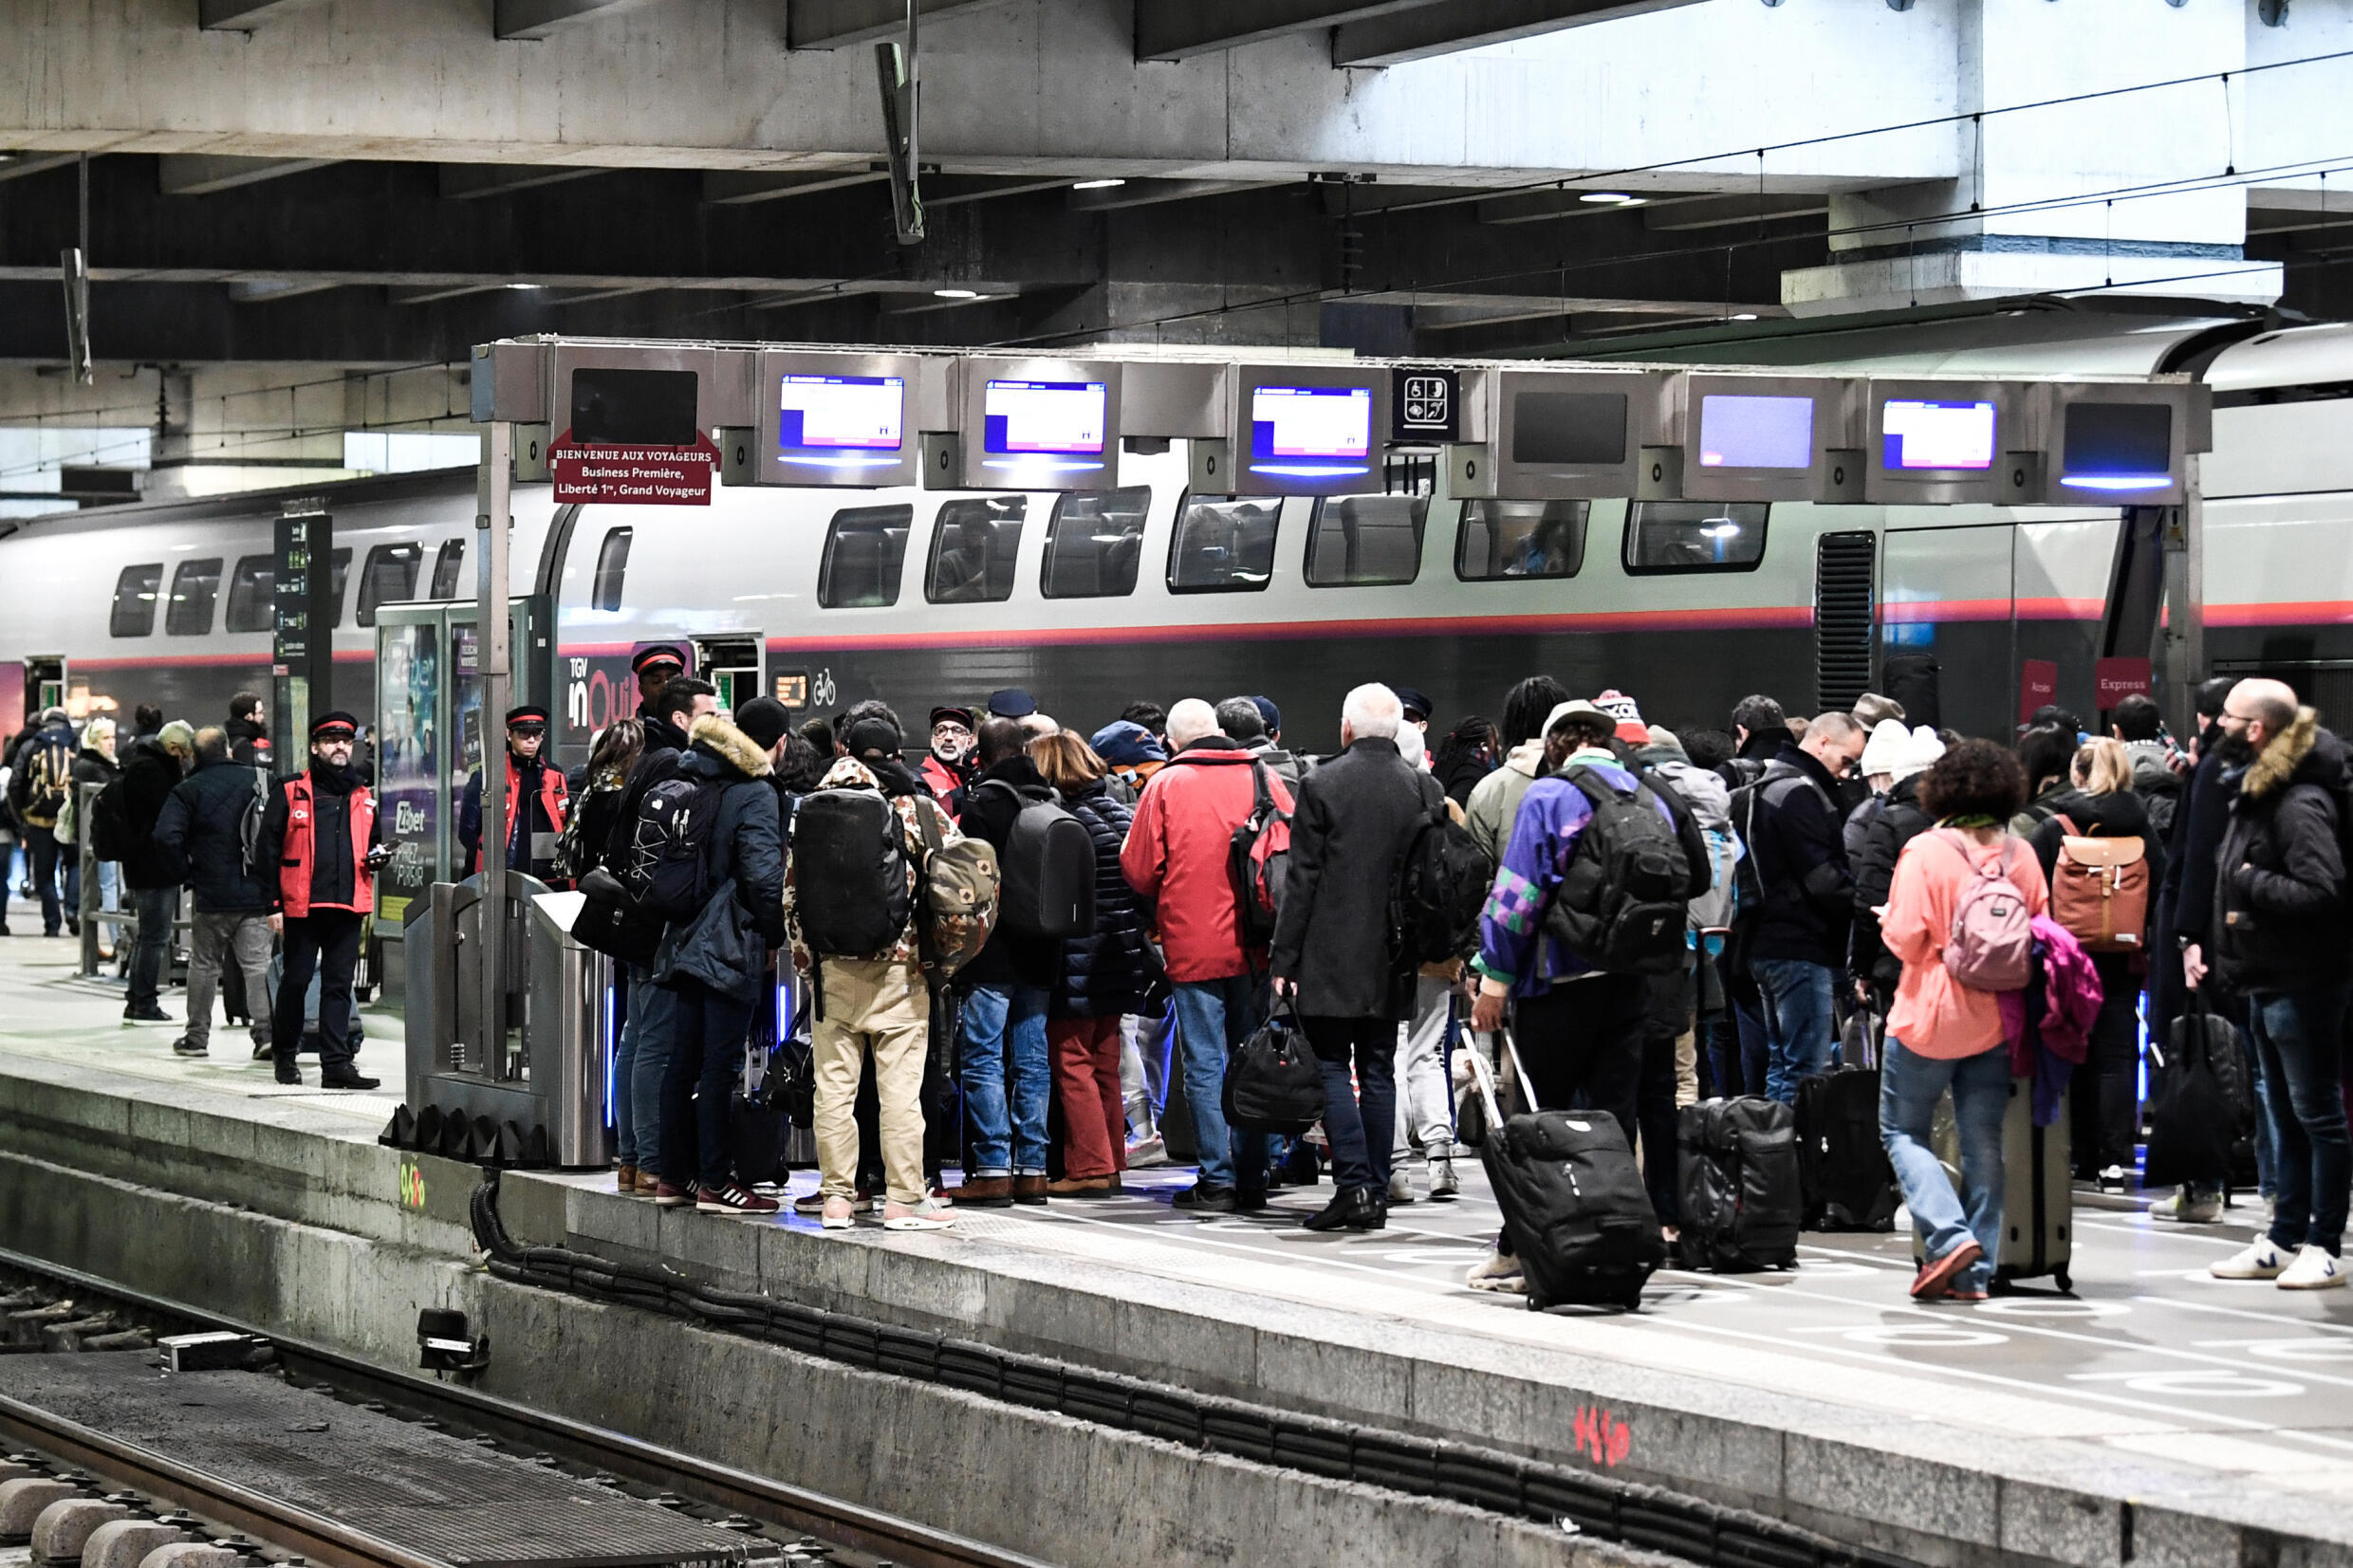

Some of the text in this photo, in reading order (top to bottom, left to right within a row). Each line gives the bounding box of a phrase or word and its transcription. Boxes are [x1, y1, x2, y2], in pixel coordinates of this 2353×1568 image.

[556, 450, 712, 462] BIENVENUE AUX VOYAGEURS
[582, 467, 685, 481] Business Première,
[558, 483, 599, 494] Liberté
[619, 484, 653, 495] Grand
[655, 485, 706, 499] Voyageur
[569, 657, 588, 678] TGV
[2100, 678, 2146, 692] Express
